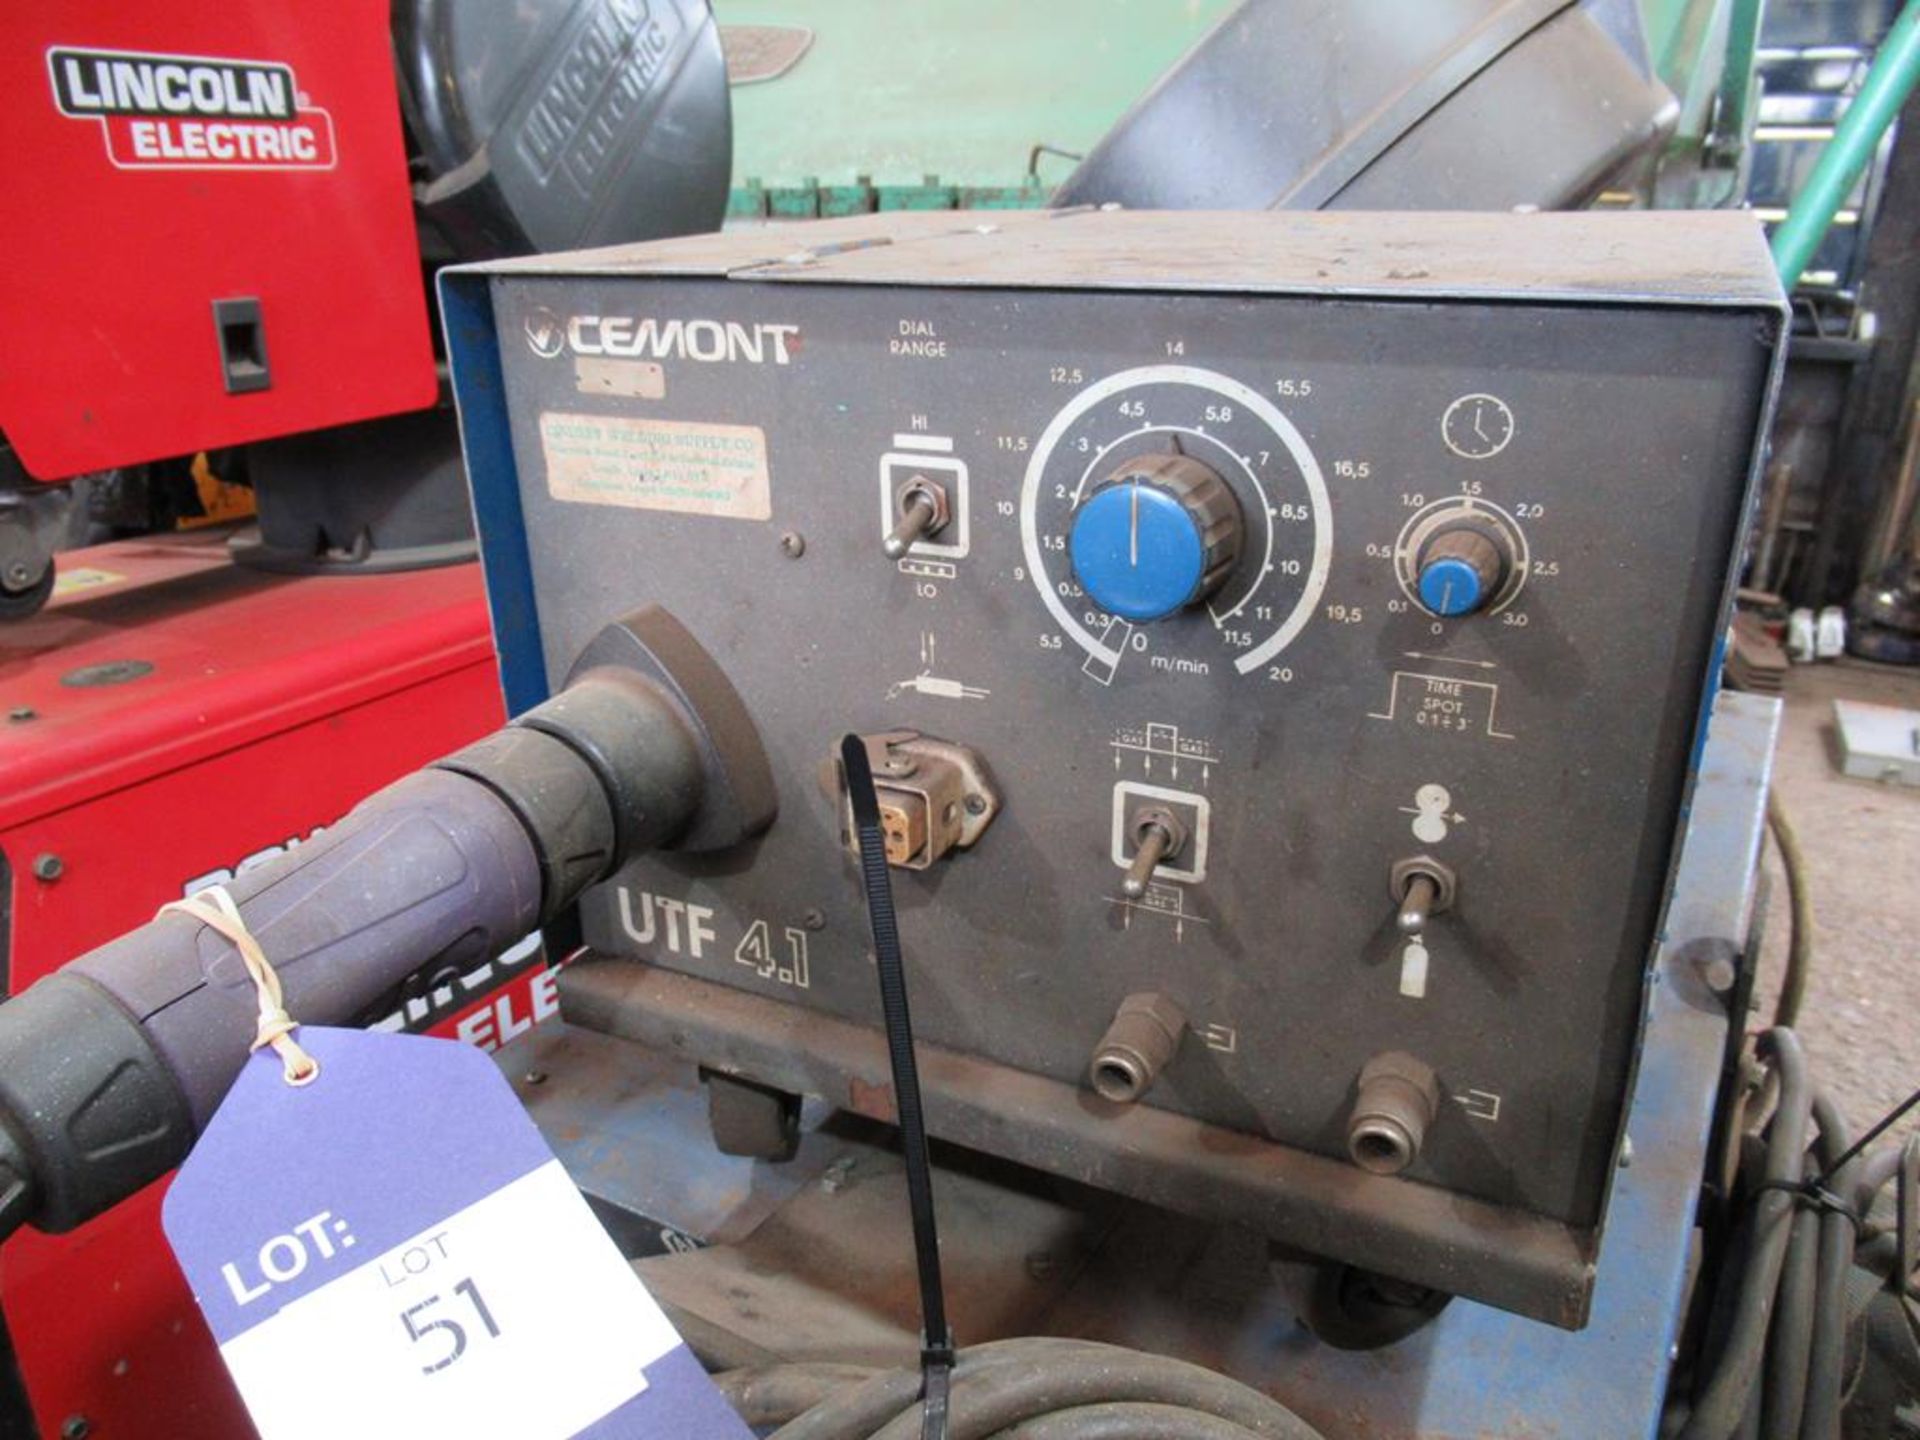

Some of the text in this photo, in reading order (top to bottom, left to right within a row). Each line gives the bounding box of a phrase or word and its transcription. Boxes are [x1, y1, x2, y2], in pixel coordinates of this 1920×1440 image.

[63, 58, 289, 116] LINCOLN
[131, 121, 317, 160] ELECTRIC
[899, 320, 936, 337] DIAL
[567, 315, 799, 365] CEMONT
[889, 340, 947, 357] RANGE
[1165, 341, 1185, 356] 14
[911, 414, 928, 430] HI
[1079, 438, 1089, 453] 3
[1259, 451, 1270, 466] 7
[1055, 485, 1065, 499] 2
[996, 501, 1014, 516] 10
[1014, 566, 1025, 581] 9
[1281, 559, 1300, 575] 10
[916, 583, 937, 598] LO
[1256, 605, 1272, 620] 11
[1430, 622, 1442, 635] 0
[1132, 633, 1148, 652] 0
[1151, 655, 1209, 675] m/min
[1269, 665, 1292, 682] 20
[1426, 679, 1462, 697] TIME
[1423, 696, 1463, 714] SPOT
[617, 886, 810, 988] UTF 4.1
[221, 1211, 356, 1307] LOT:
[379, 1231, 450, 1288] LOT
[399, 1277, 502, 1375] 51
